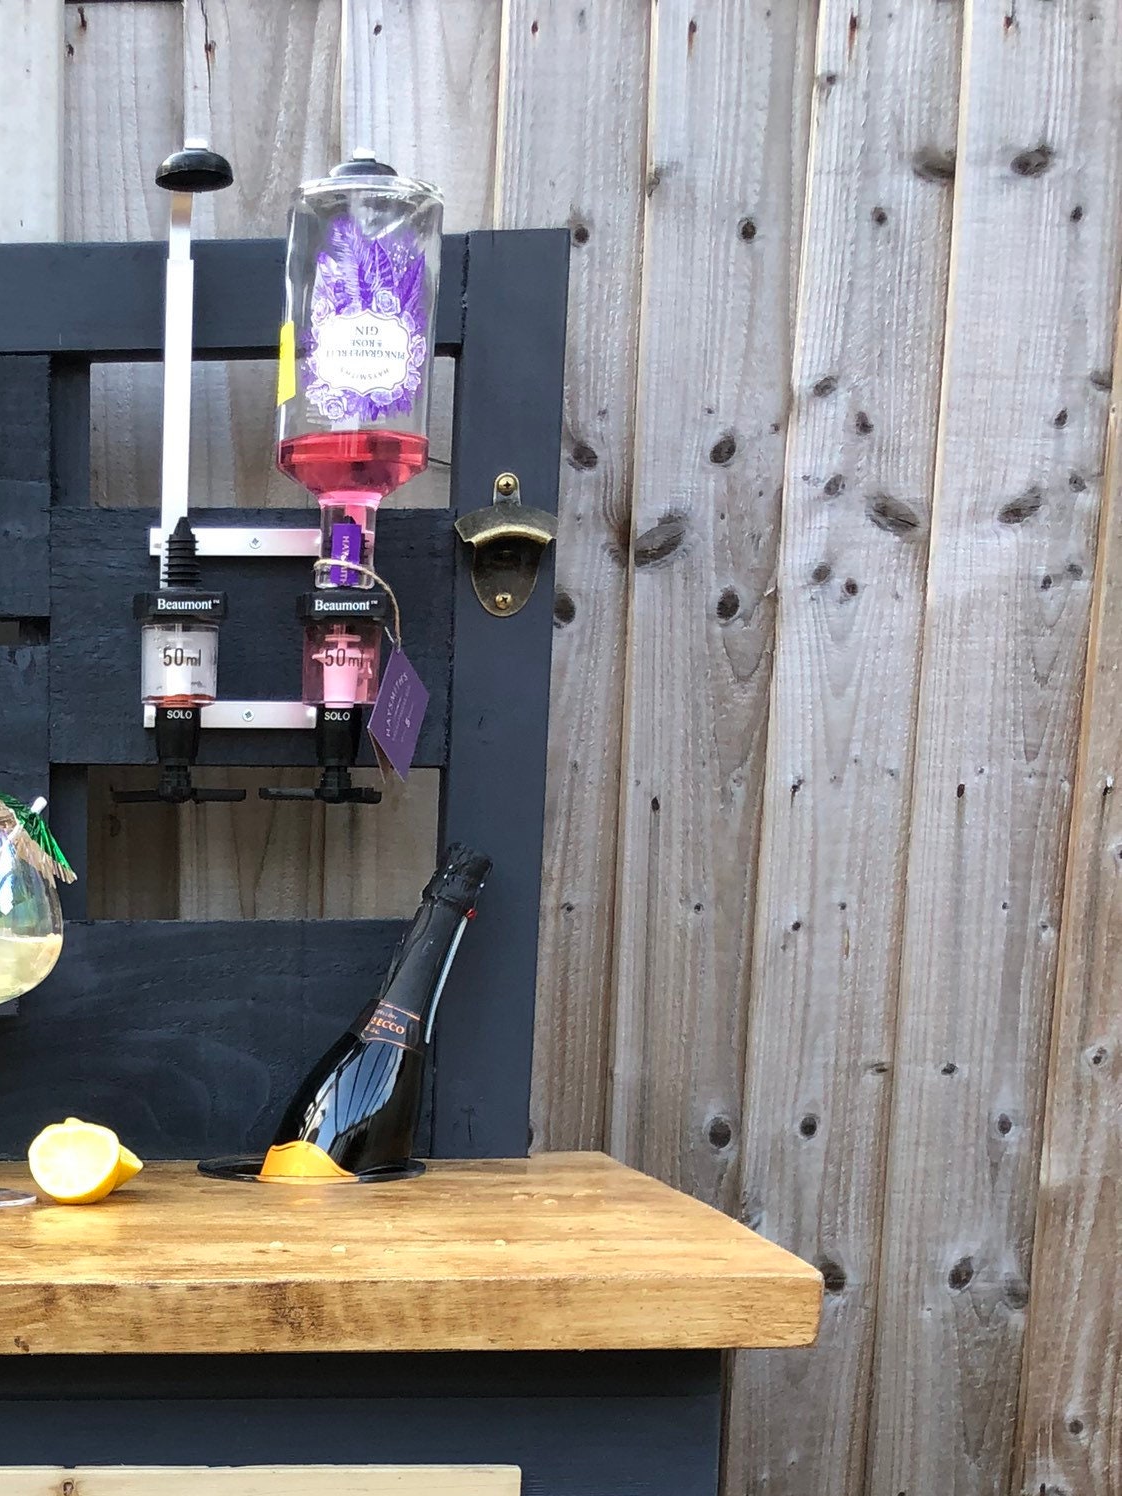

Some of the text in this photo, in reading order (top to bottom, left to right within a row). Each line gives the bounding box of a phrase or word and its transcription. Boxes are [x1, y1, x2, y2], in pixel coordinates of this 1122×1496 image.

[355, 325, 379, 336] GIN
[166, 710, 193, 719] SOLO
[324, 711, 351, 721] SOLO
